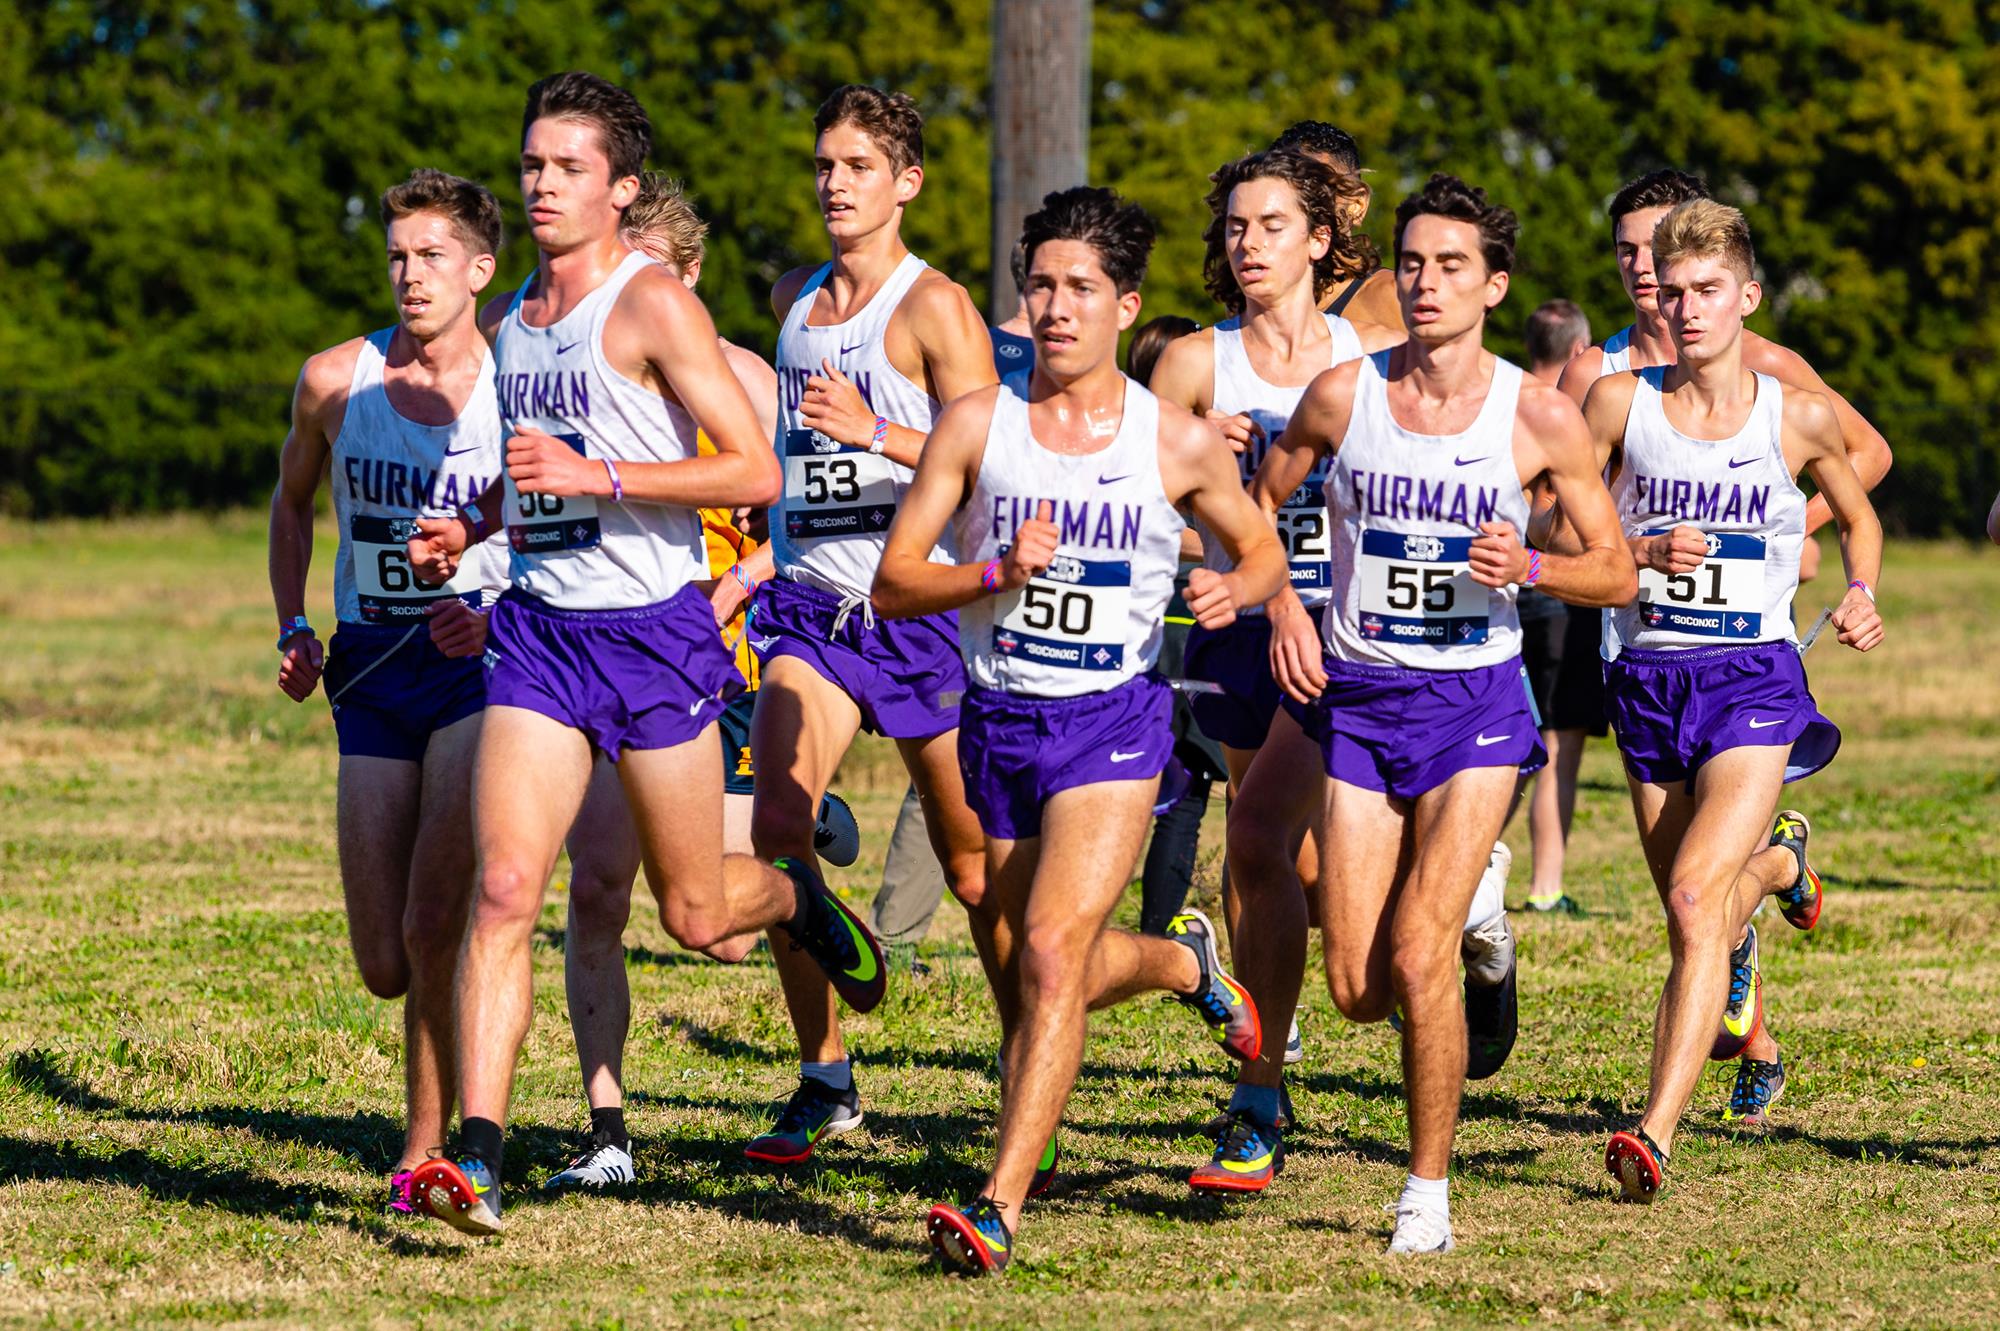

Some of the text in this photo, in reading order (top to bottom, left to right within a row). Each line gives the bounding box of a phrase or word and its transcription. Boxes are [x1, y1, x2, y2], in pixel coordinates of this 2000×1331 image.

[500, 371, 590, 419] URMAN
[345, 456, 488, 510] FURMAN
[804, 459, 861, 504] 53
[1351, 469, 1498, 528] FURMAN
[1632, 474, 1770, 525] FURMAN
[1386, 565, 1455, 612] 55
[1666, 563, 1728, 605] 51
[1023, 583, 1094, 636] 50
